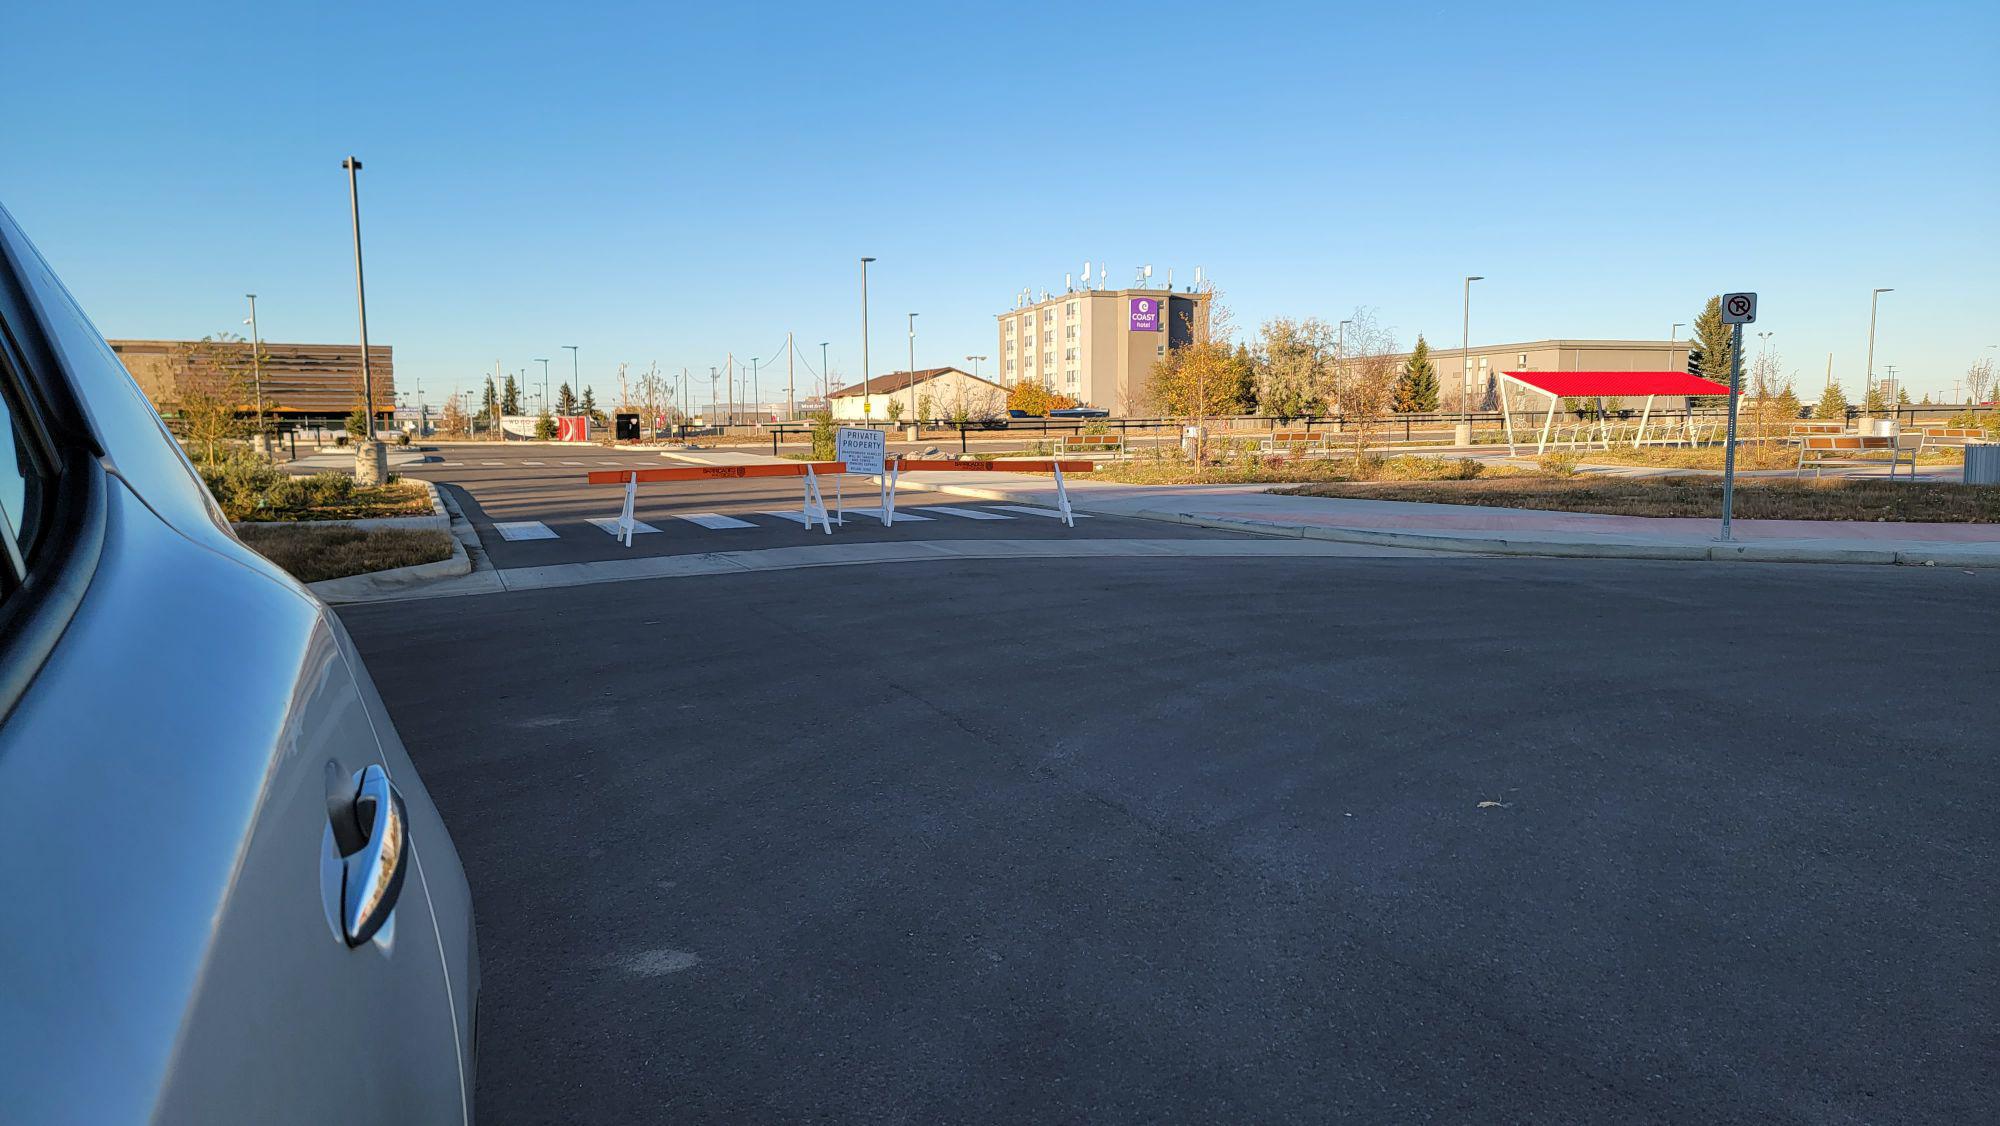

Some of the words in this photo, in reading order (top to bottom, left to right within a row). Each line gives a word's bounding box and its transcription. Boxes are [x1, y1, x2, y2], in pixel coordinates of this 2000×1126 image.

[1132, 313, 1155, 321] COAST
[847, 431, 878, 441] PRIVATE
[843, 440, 881, 449] PROPERTY
